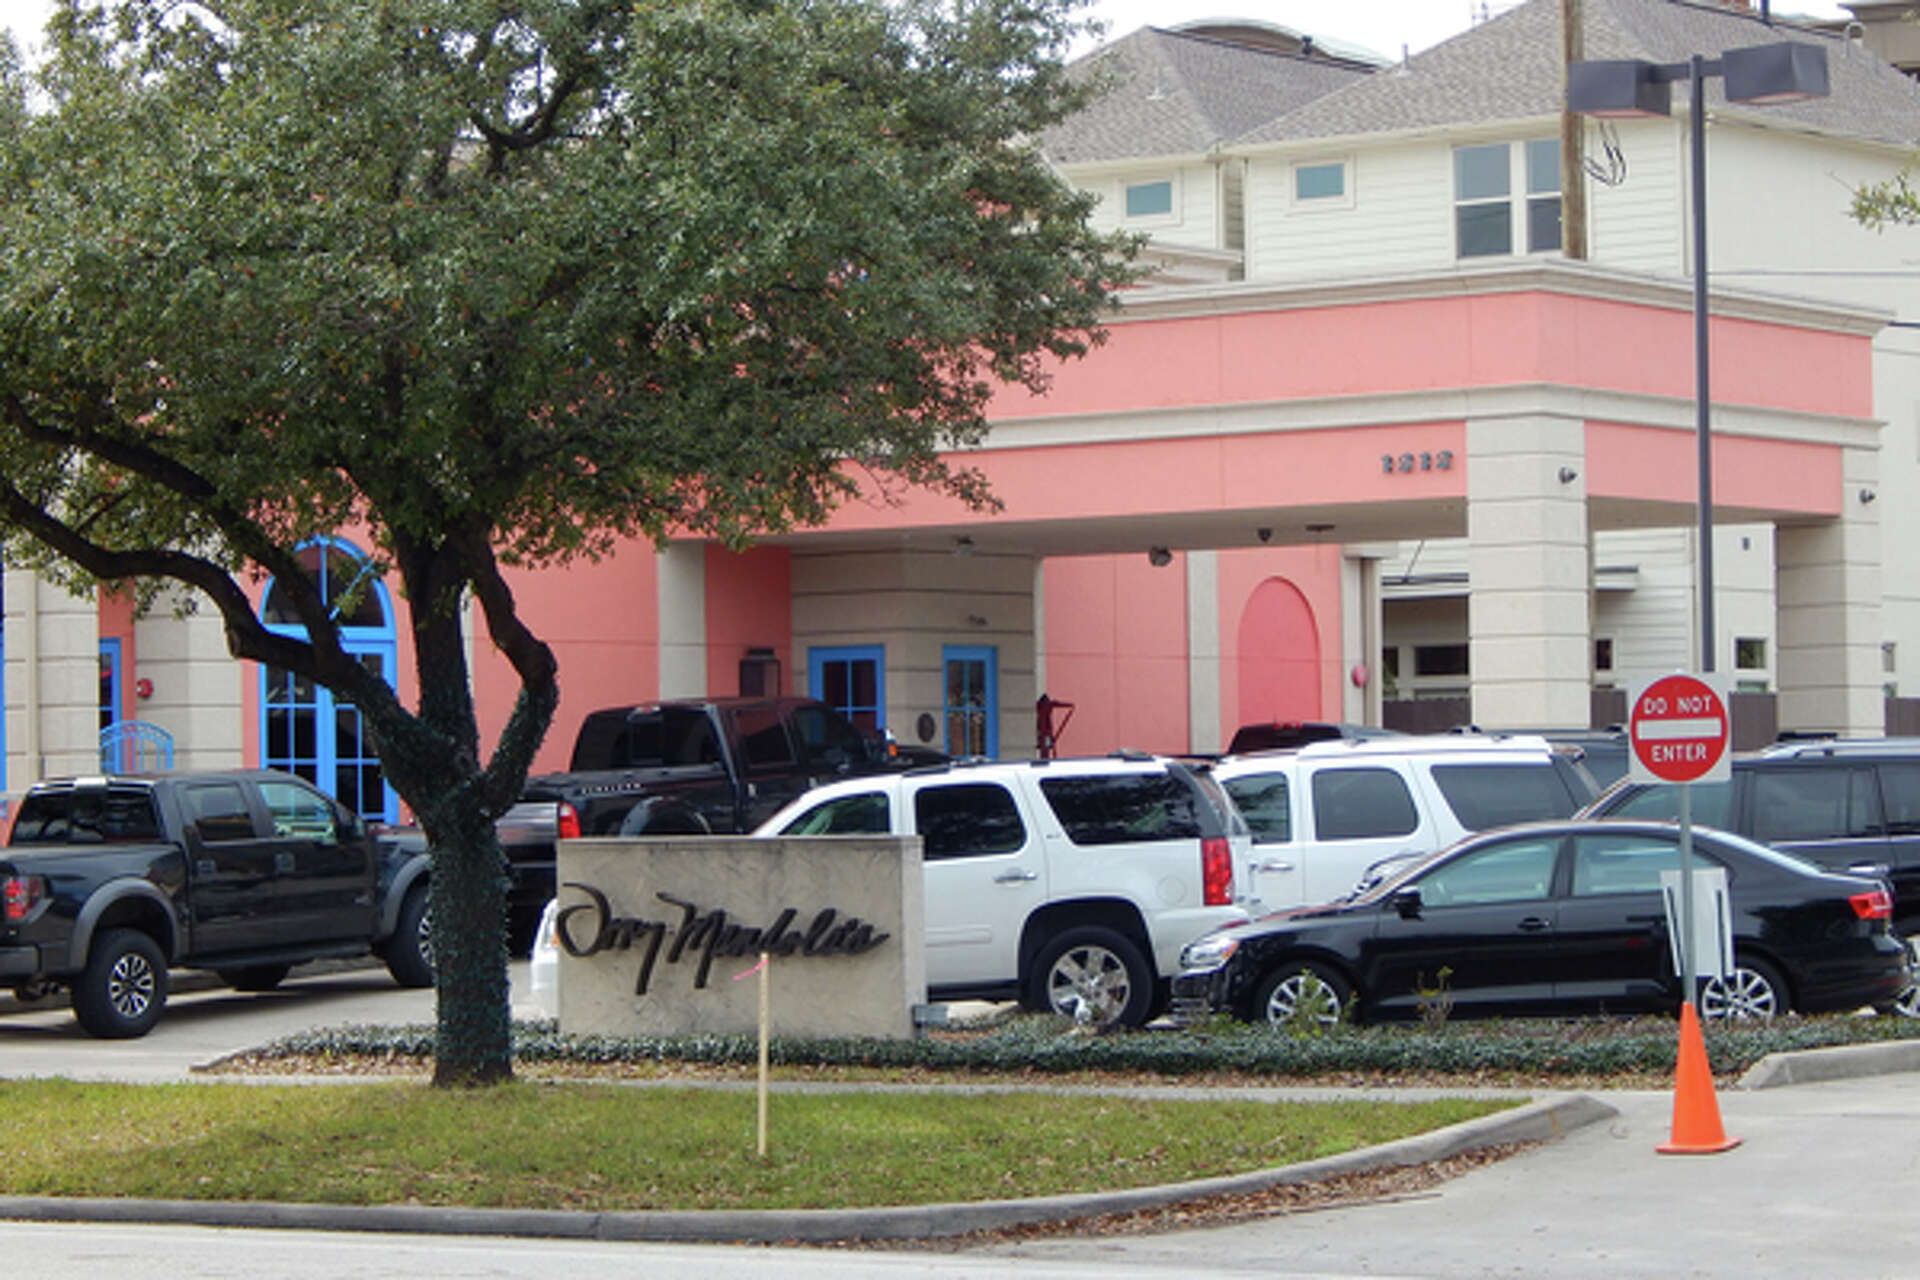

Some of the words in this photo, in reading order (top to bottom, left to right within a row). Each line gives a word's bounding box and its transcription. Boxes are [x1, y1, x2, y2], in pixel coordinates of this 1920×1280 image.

[1643, 697, 1668, 715] DO
[1677, 695, 1712, 714] NOT
[1651, 743, 1707, 762] ENTER
